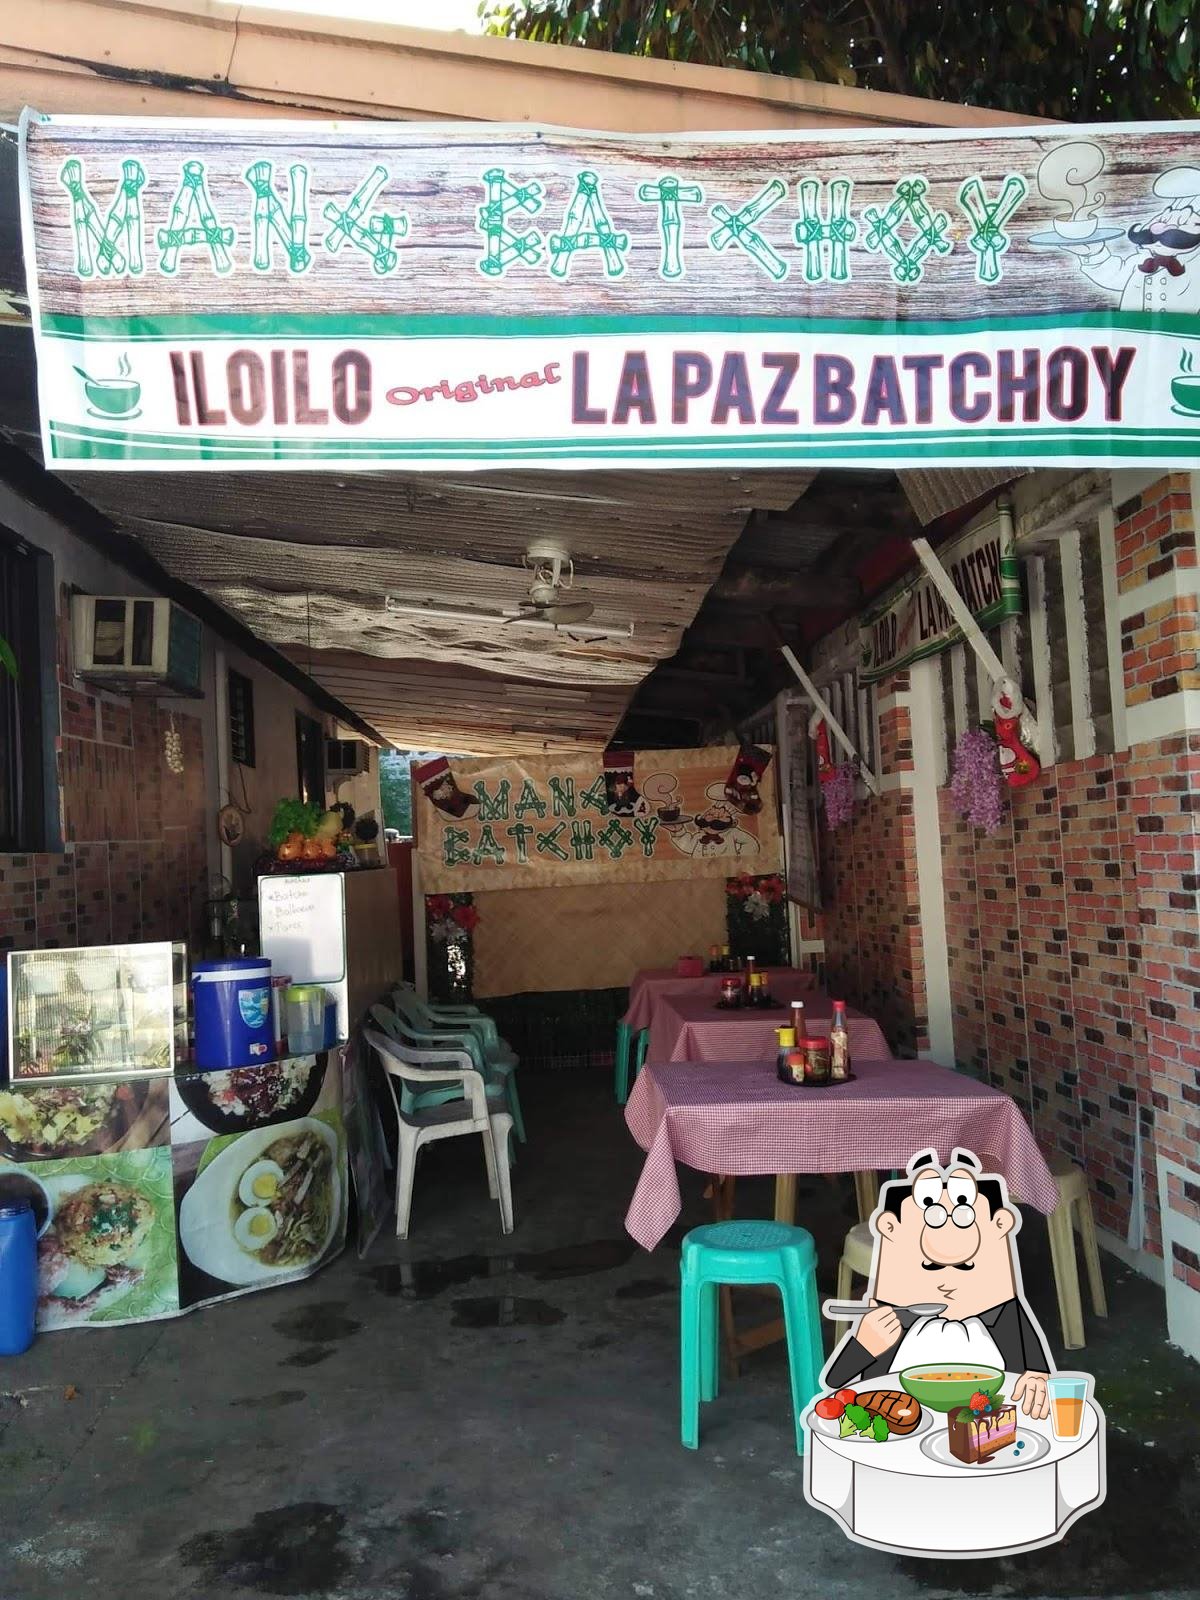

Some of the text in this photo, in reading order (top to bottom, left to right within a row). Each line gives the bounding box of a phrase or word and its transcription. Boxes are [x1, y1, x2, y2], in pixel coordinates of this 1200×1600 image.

[60, 158, 1027, 284] MANG BATCHOY
[169, 348, 373, 426] ILOILO
[385, 361, 562, 406] Original
[812, 345, 1137, 426] BATCHOY
[444, 816, 660, 866] BATCHOY
